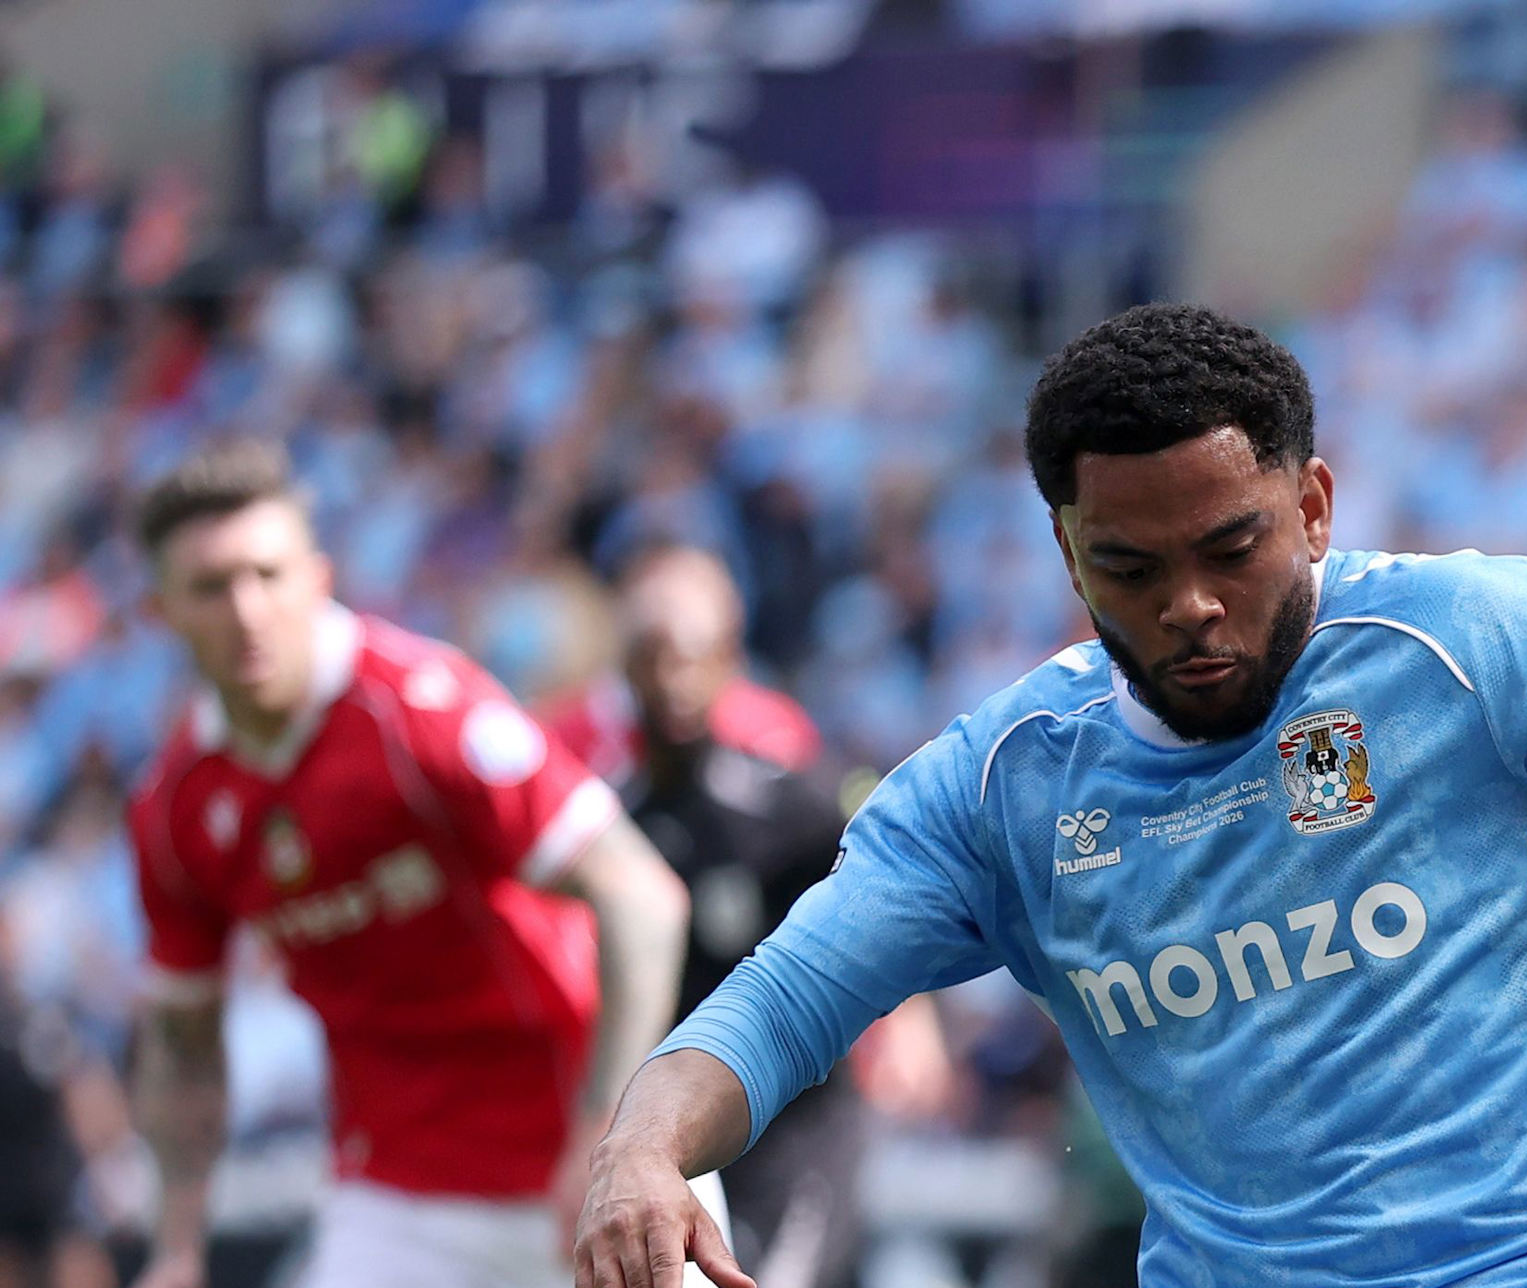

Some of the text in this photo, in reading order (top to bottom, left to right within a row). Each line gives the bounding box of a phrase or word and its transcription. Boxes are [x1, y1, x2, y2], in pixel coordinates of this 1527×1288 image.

[1287, 715, 1327, 733] COVENTRY
[1141, 777, 1267, 828] Coventry City Football Club
[1141, 790, 1269, 839] EFL Sky Bet Championship
[1168, 810, 1244, 846] Champions 2026
[1305, 811, 1365, 832] FOOTBALL CLUB
[1055, 847, 1121, 876] hummel
[1066, 882, 1427, 1037] monzo
